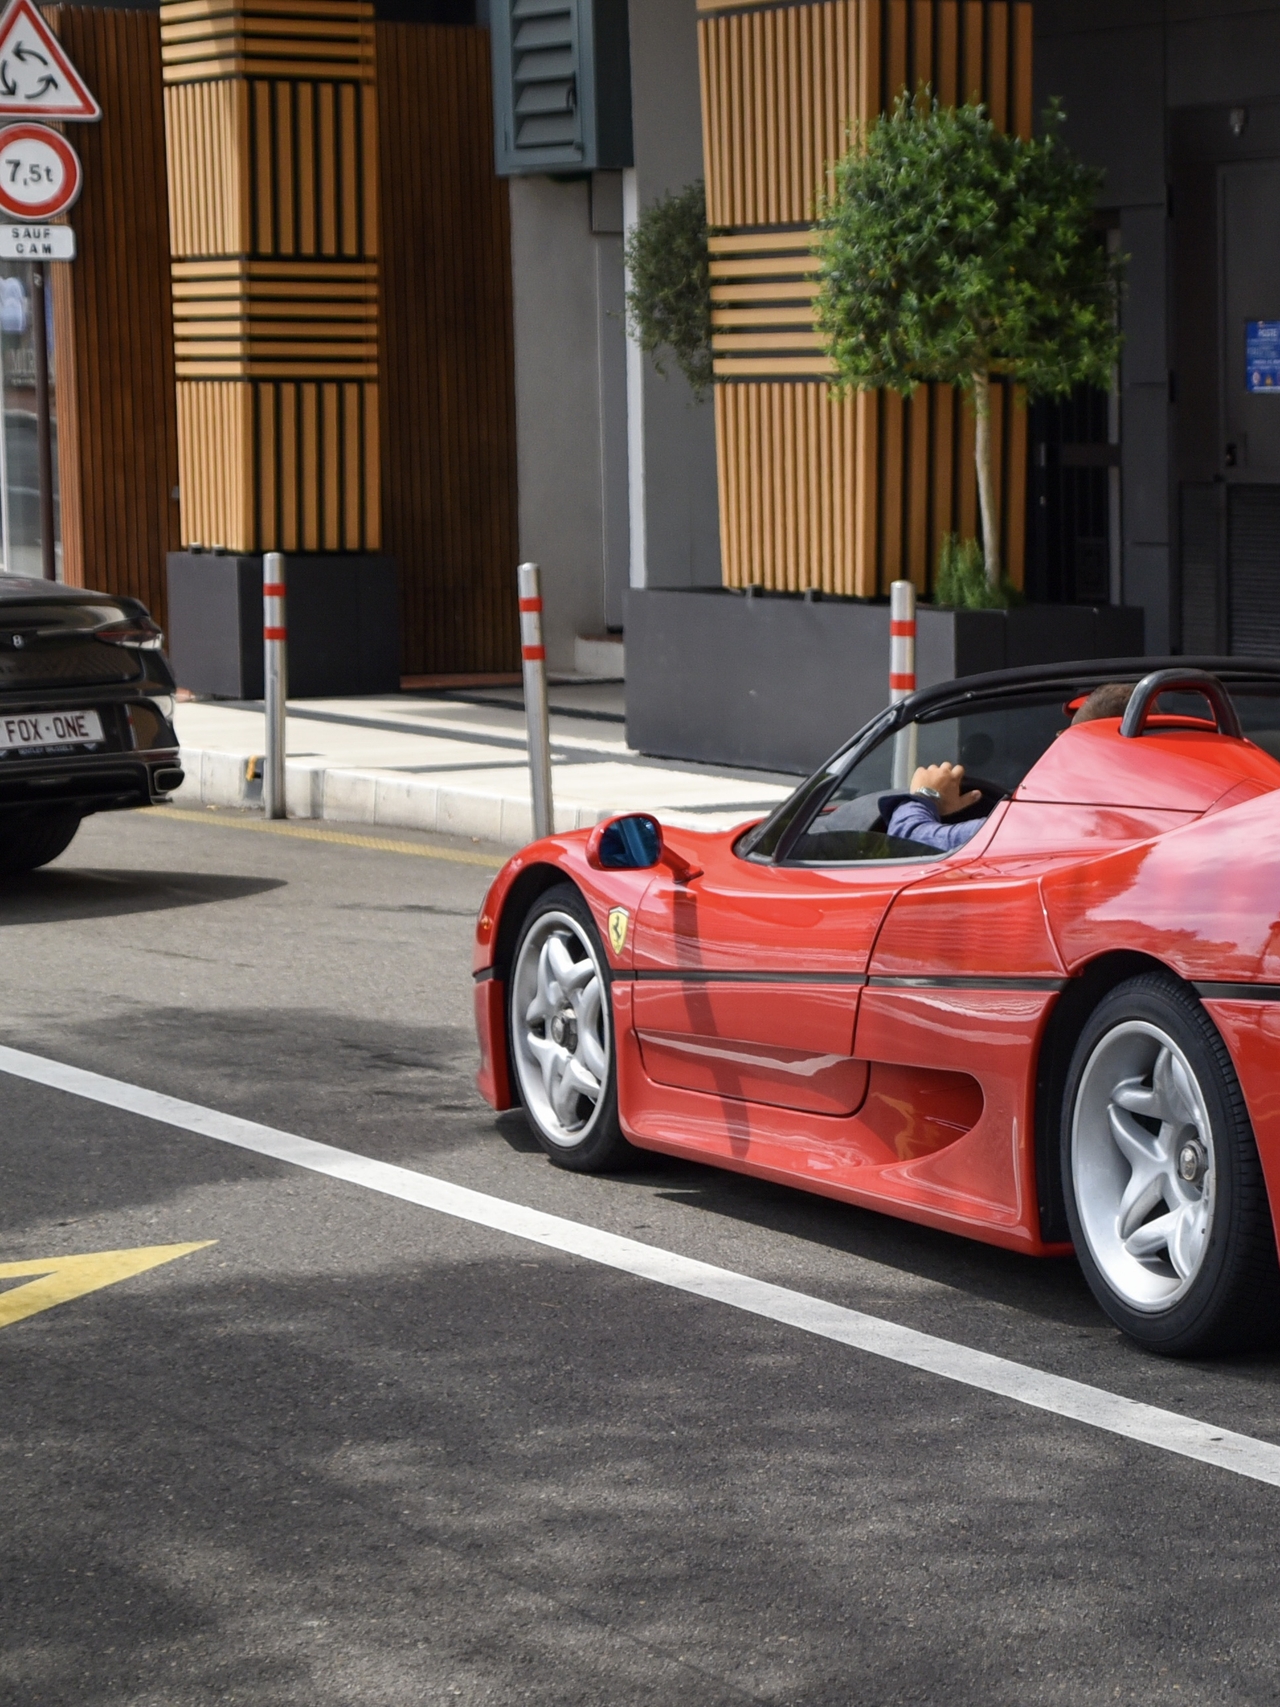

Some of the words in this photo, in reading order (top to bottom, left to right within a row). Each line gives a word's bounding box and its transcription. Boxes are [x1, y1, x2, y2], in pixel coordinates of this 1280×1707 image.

[5, 159, 53, 186] 7,5t
[11, 227, 51, 239] SAUF
[15, 243, 52, 254] CAM
